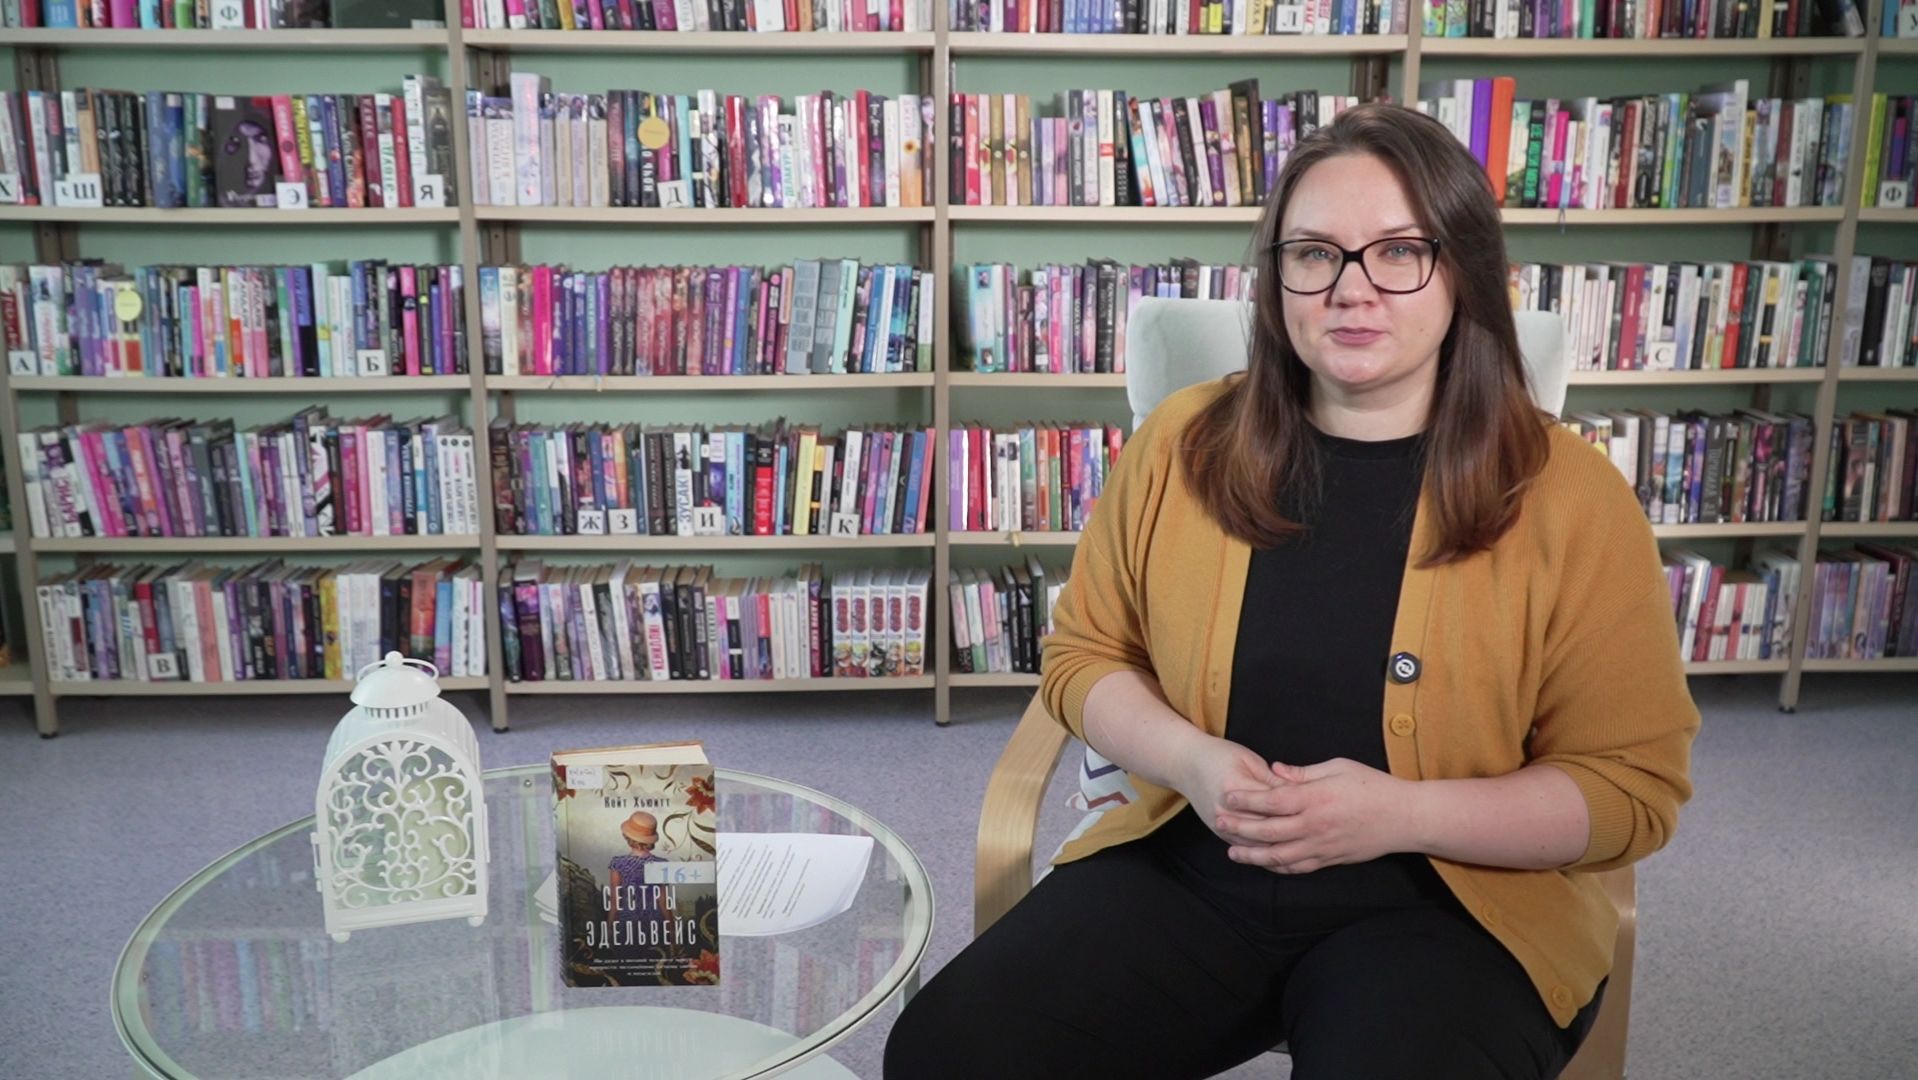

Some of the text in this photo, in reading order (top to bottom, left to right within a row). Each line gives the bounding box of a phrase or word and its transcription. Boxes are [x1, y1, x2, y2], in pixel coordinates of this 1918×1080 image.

[219, 5, 239, 21] Ф
[73, 183, 97, 200] Ш
[286, 188, 300, 205] Э
[420, 185, 433, 200] Я
[1885, 186, 1902, 202] Ф
[1654, 347, 1670, 364] С
[15, 357, 30, 372] А
[366, 356, 379, 372] Б
[676, 478, 691, 523] ЗУСАК
[581, 516, 600, 530] Ж
[616, 514, 628, 529] З
[701, 513, 714, 527] И
[838, 519, 852, 534] К
[156, 658, 170, 673] В
[604, 796, 671, 809] Кейт Хьюитт
[660, 866, 702, 884] 16+
[602, 885, 677, 912] СЕСТРЫ
[586, 916, 697, 949] ЭДЕЛЬВЕЙС
